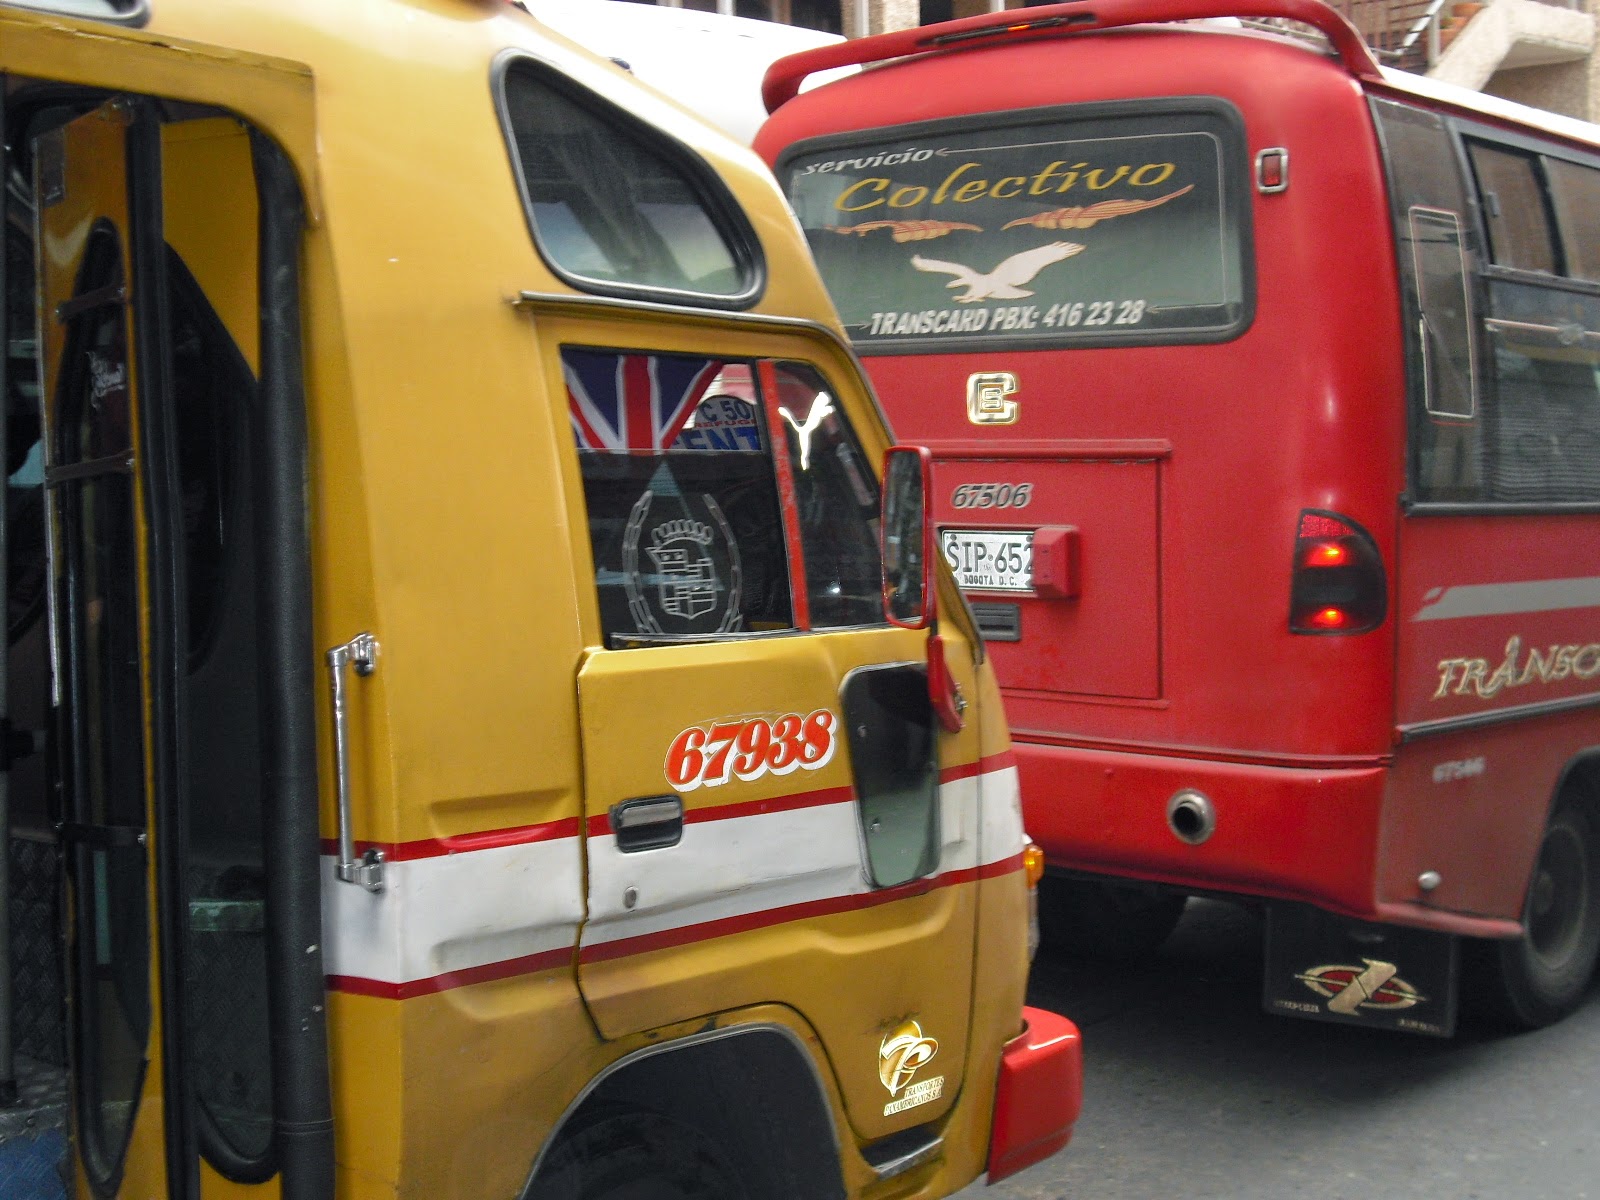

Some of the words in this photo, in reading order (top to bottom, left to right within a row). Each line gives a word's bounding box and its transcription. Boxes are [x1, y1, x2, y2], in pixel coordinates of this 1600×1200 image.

[801, 147, 934, 176] servicio
[834, 160, 1176, 212] Colectivo
[870, 308, 989, 335] TRANSCARD
[989, 305, 1040, 330] PBX:
[1042, 302, 1084, 327] 416
[1083, 301, 1115, 326] 23
[1114, 299, 1147, 325] 28
[720, 400, 751, 420] 50
[673, 426, 761, 450] ENT
[952, 482, 1033, 510] 67506
[964, 575, 994, 586] BOGOTA
[664, 708, 838, 793] 67938
